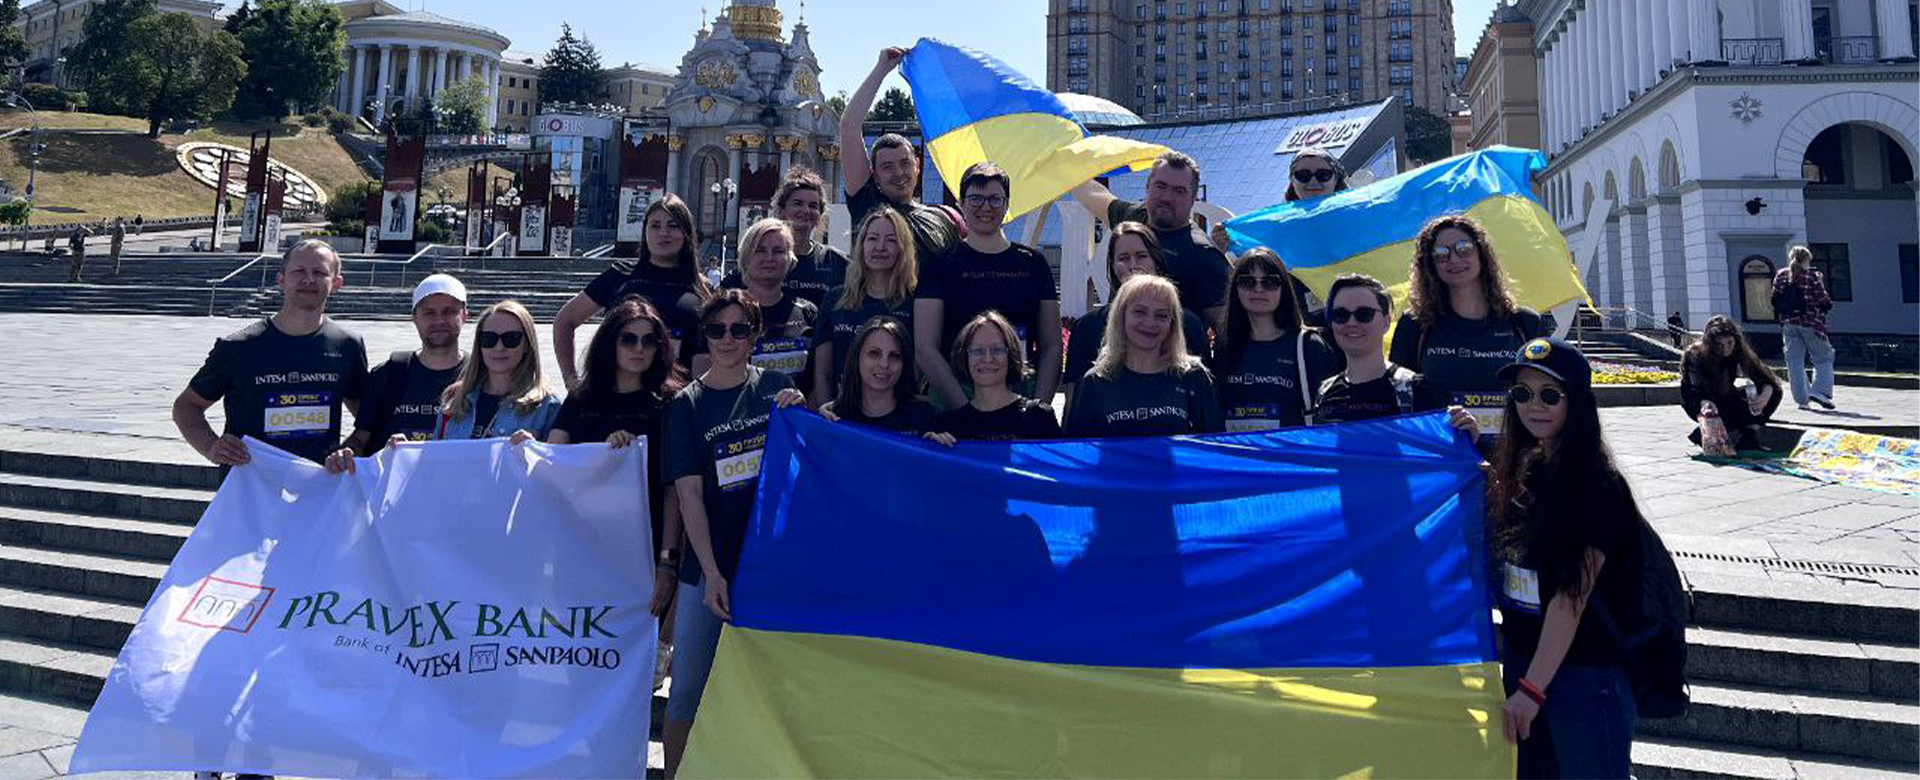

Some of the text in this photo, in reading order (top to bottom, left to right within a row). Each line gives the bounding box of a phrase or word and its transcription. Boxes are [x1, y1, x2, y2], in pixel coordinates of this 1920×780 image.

[539, 120, 585, 134] GLOBUS
[255, 373, 286, 385] INTESA
[279, 395, 297, 405] 30
[1464, 395, 1481, 406] 30
[728, 442, 743, 454] 30
[722, 454, 759, 477] 005
[277, 590, 618, 648] PRAVEX BANK
[334, 635, 393, 654] Bank of
[396, 645, 620, 679] INTESA SANPAOLO
